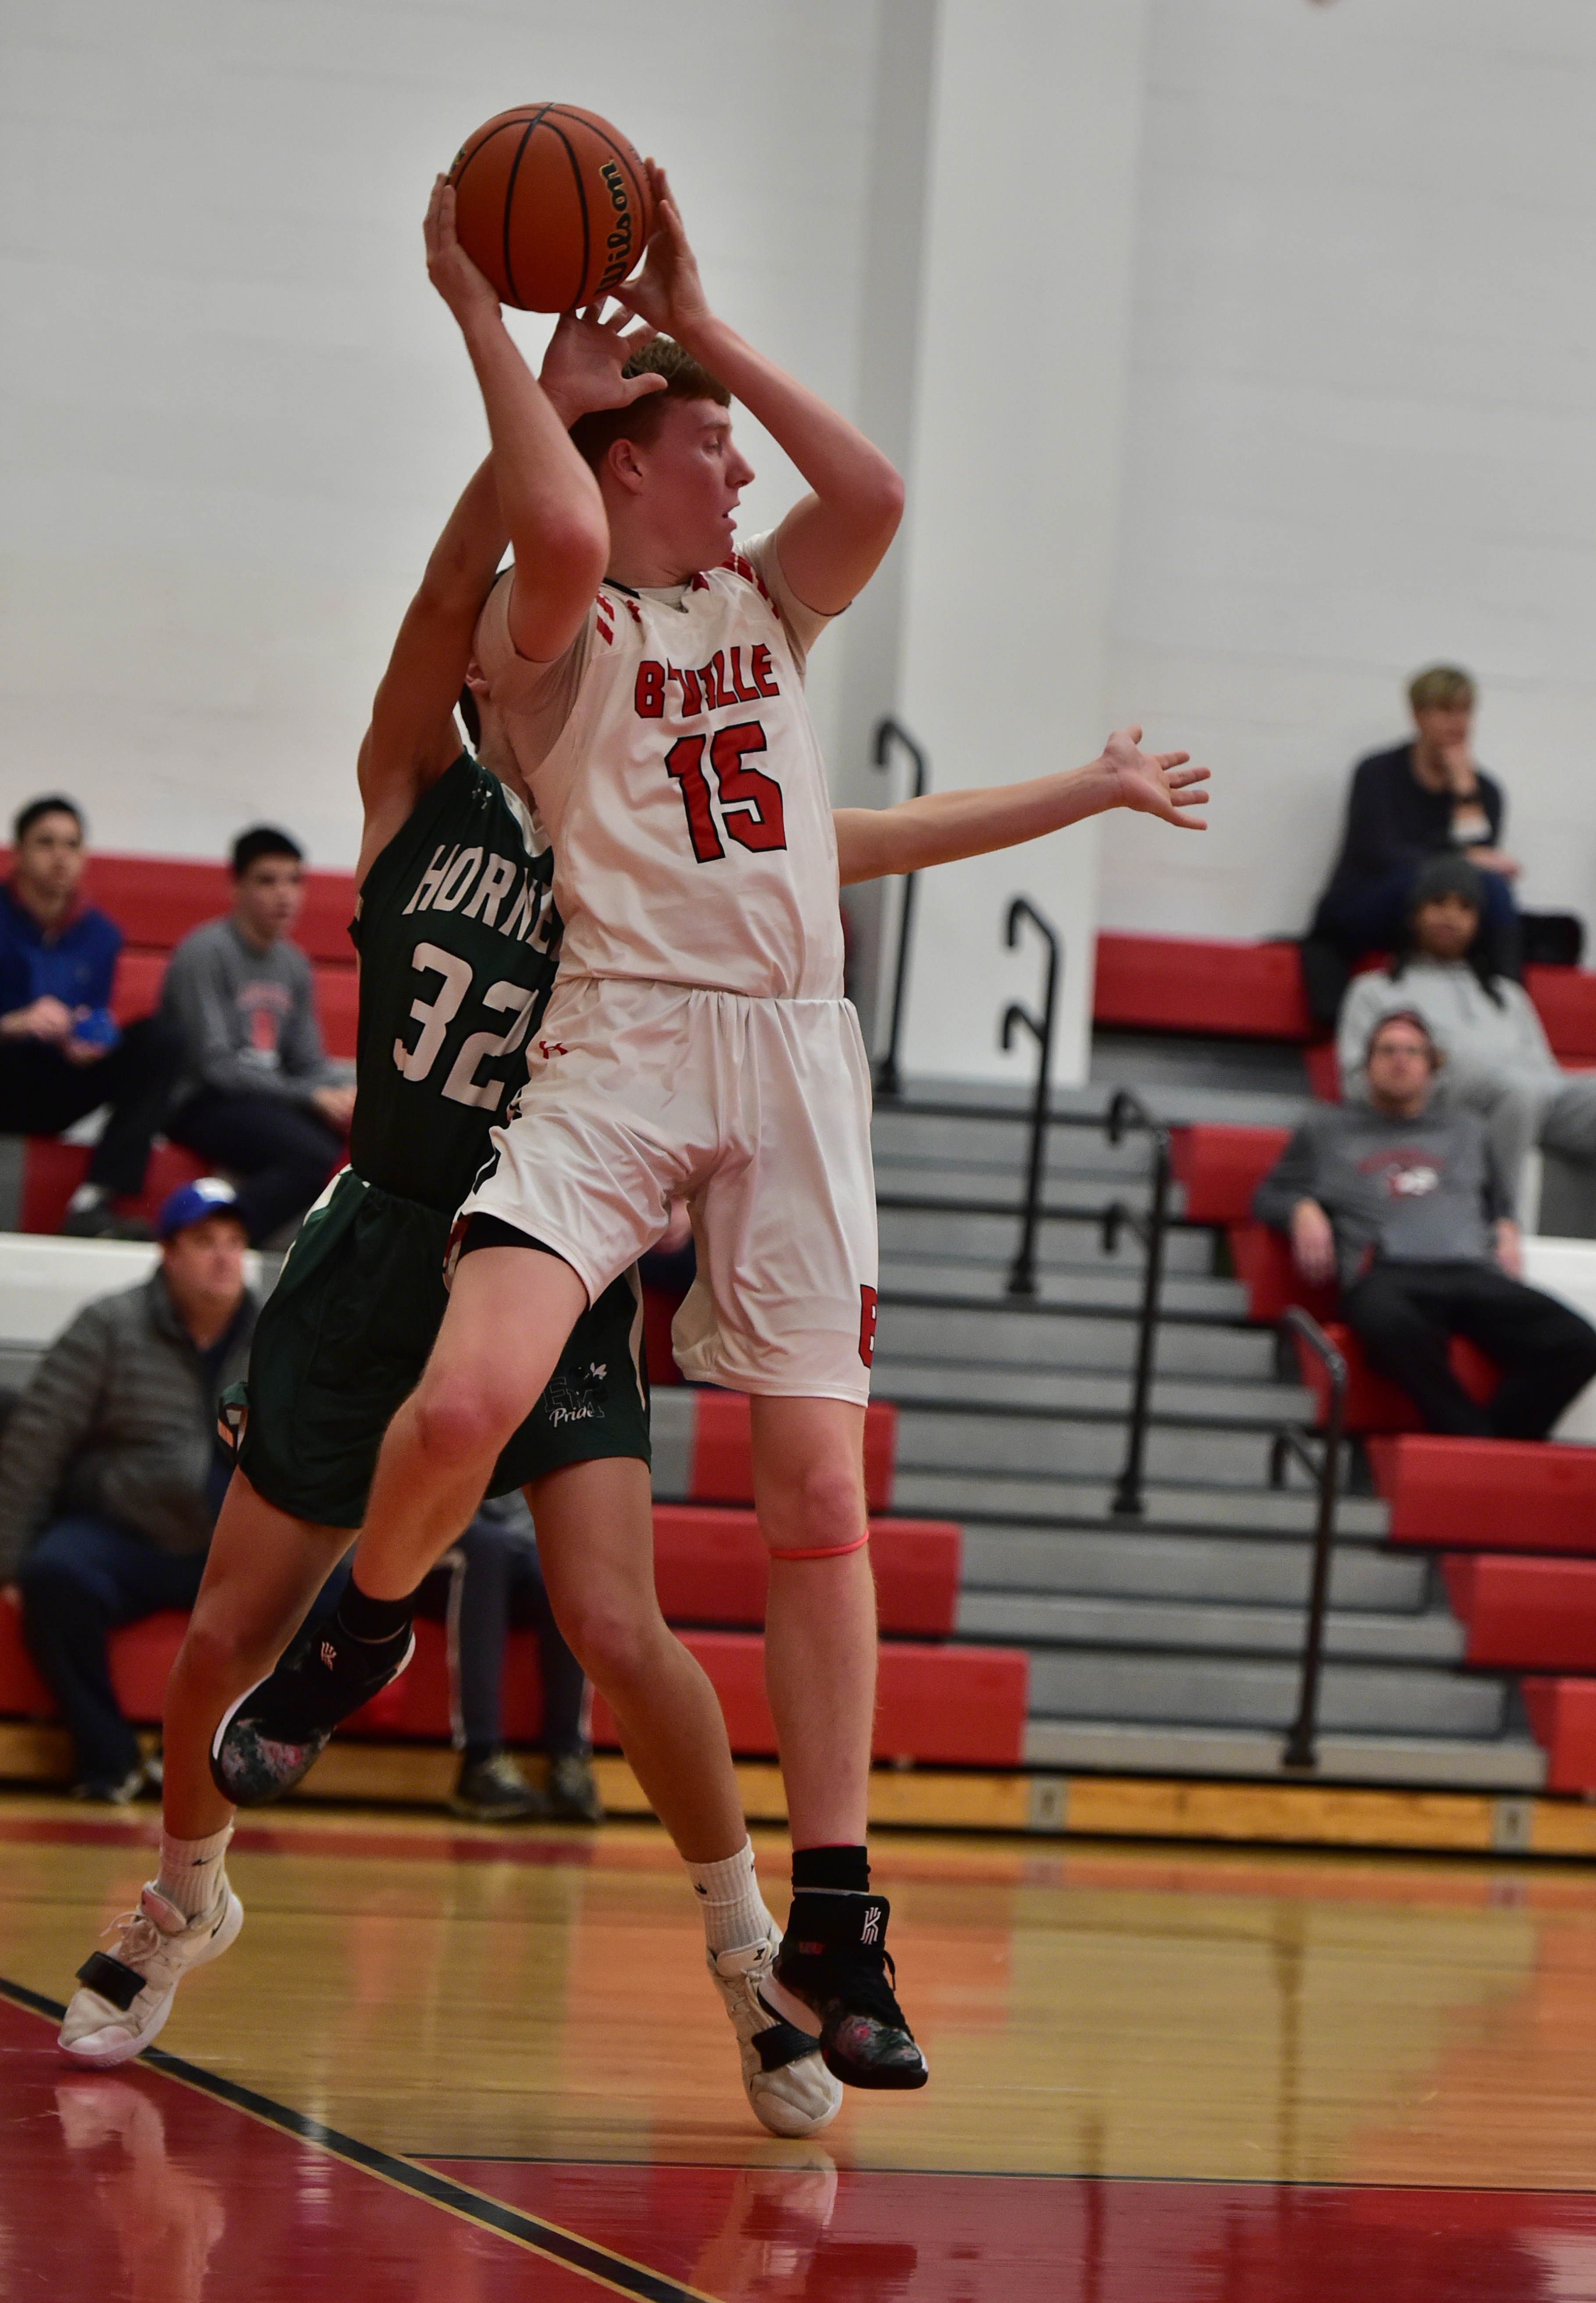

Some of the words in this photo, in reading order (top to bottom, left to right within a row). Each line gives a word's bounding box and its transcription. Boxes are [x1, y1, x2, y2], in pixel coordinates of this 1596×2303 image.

[594, 159, 631, 295] Wilson
[664, 721, 787, 864] 15
[393, 942, 539, 1111] 32
[549, 1406, 595, 1428] Pride
